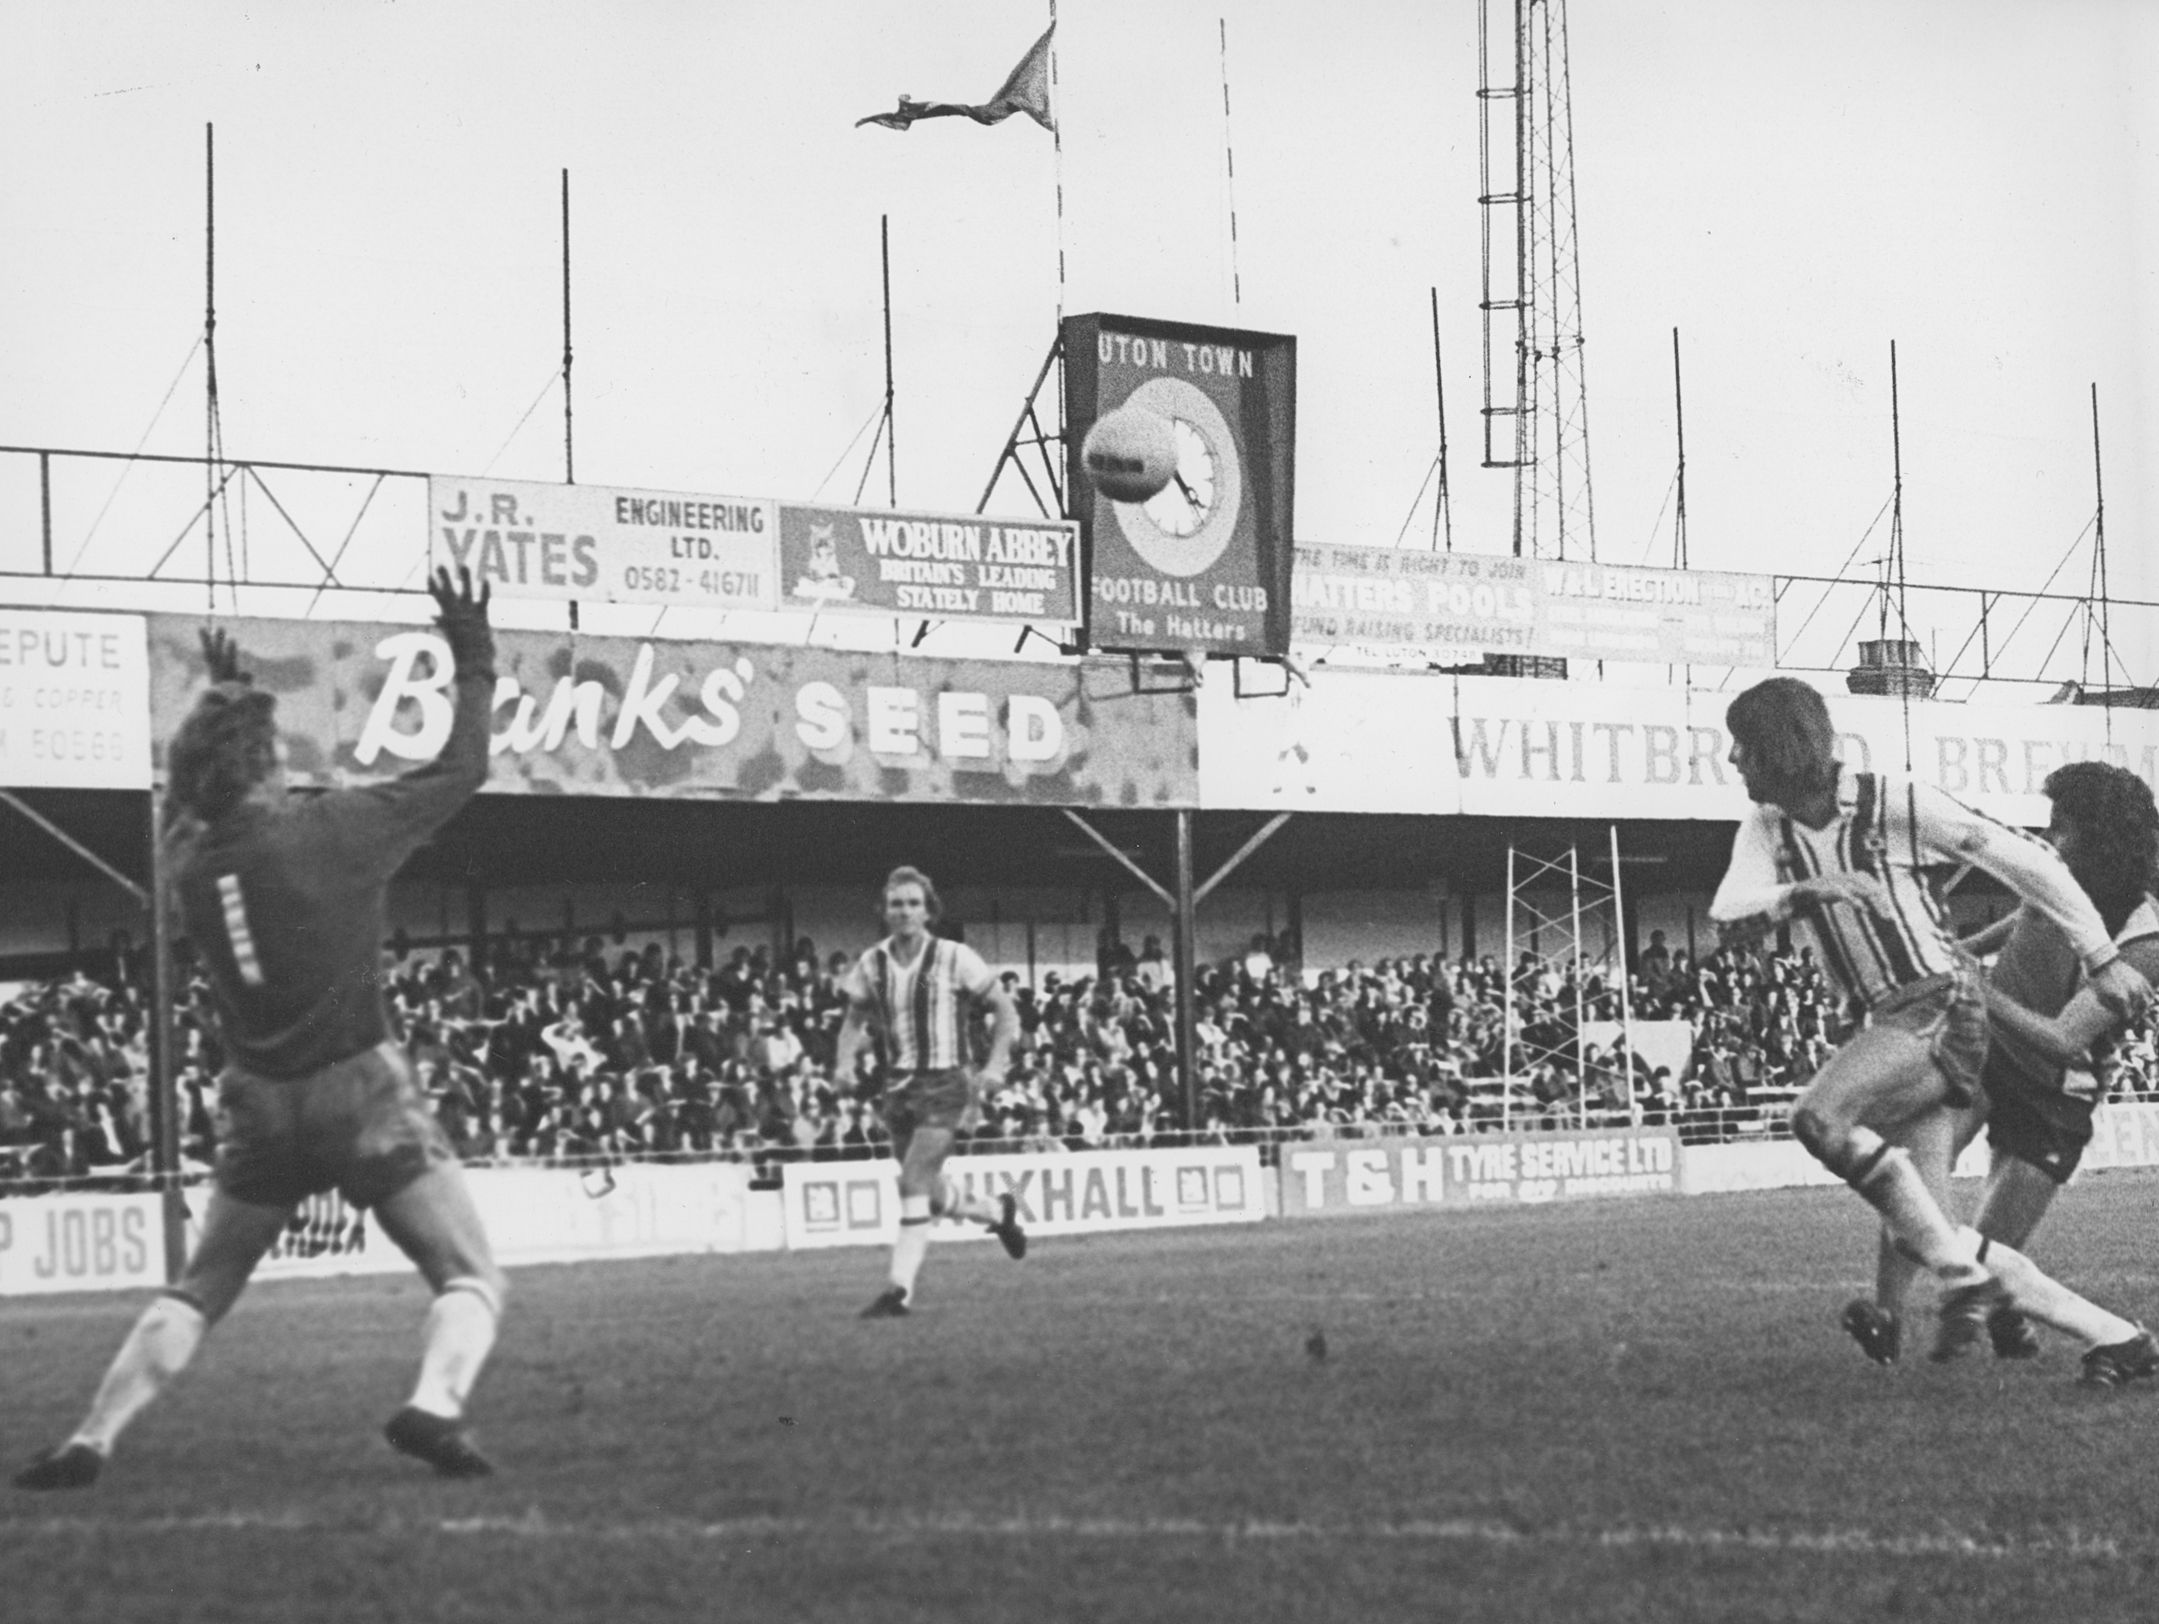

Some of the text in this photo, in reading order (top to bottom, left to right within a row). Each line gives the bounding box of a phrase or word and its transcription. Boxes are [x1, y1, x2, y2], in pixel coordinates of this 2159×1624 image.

[1183, 343, 1253, 378] TOWN
[615, 496, 764, 533] ENGINEERING
[442, 526, 598, 587] YATES
[671, 536, 720, 560] LTD.
[858, 518, 1072, 567] WOBURN ABBEY
[880, 559, 1056, 590] BRITAIN'S LEADING
[1459, 559, 1480, 578] TO
[1488, 561, 1527, 580] JOIN
[896, 585, 1045, 614] STATELY HOME
[1214, 584, 1268, 611] CLUB
[1428, 580, 1535, 619] POOLS
[1117, 611, 1246, 641] The Hatters
[1344, 617, 1415, 642] RAISING
[795, 681, 1063, 761] SEED
[1447, 716, 1871, 789] WHITBRD
[1291, 1145, 1444, 1208] T & H
[1448, 1136, 1673, 1182] TYRE SERVICE LTD
[895, 1165, 1165, 1227] UXHALL
[34, 1206, 147, 1279] JOBS
